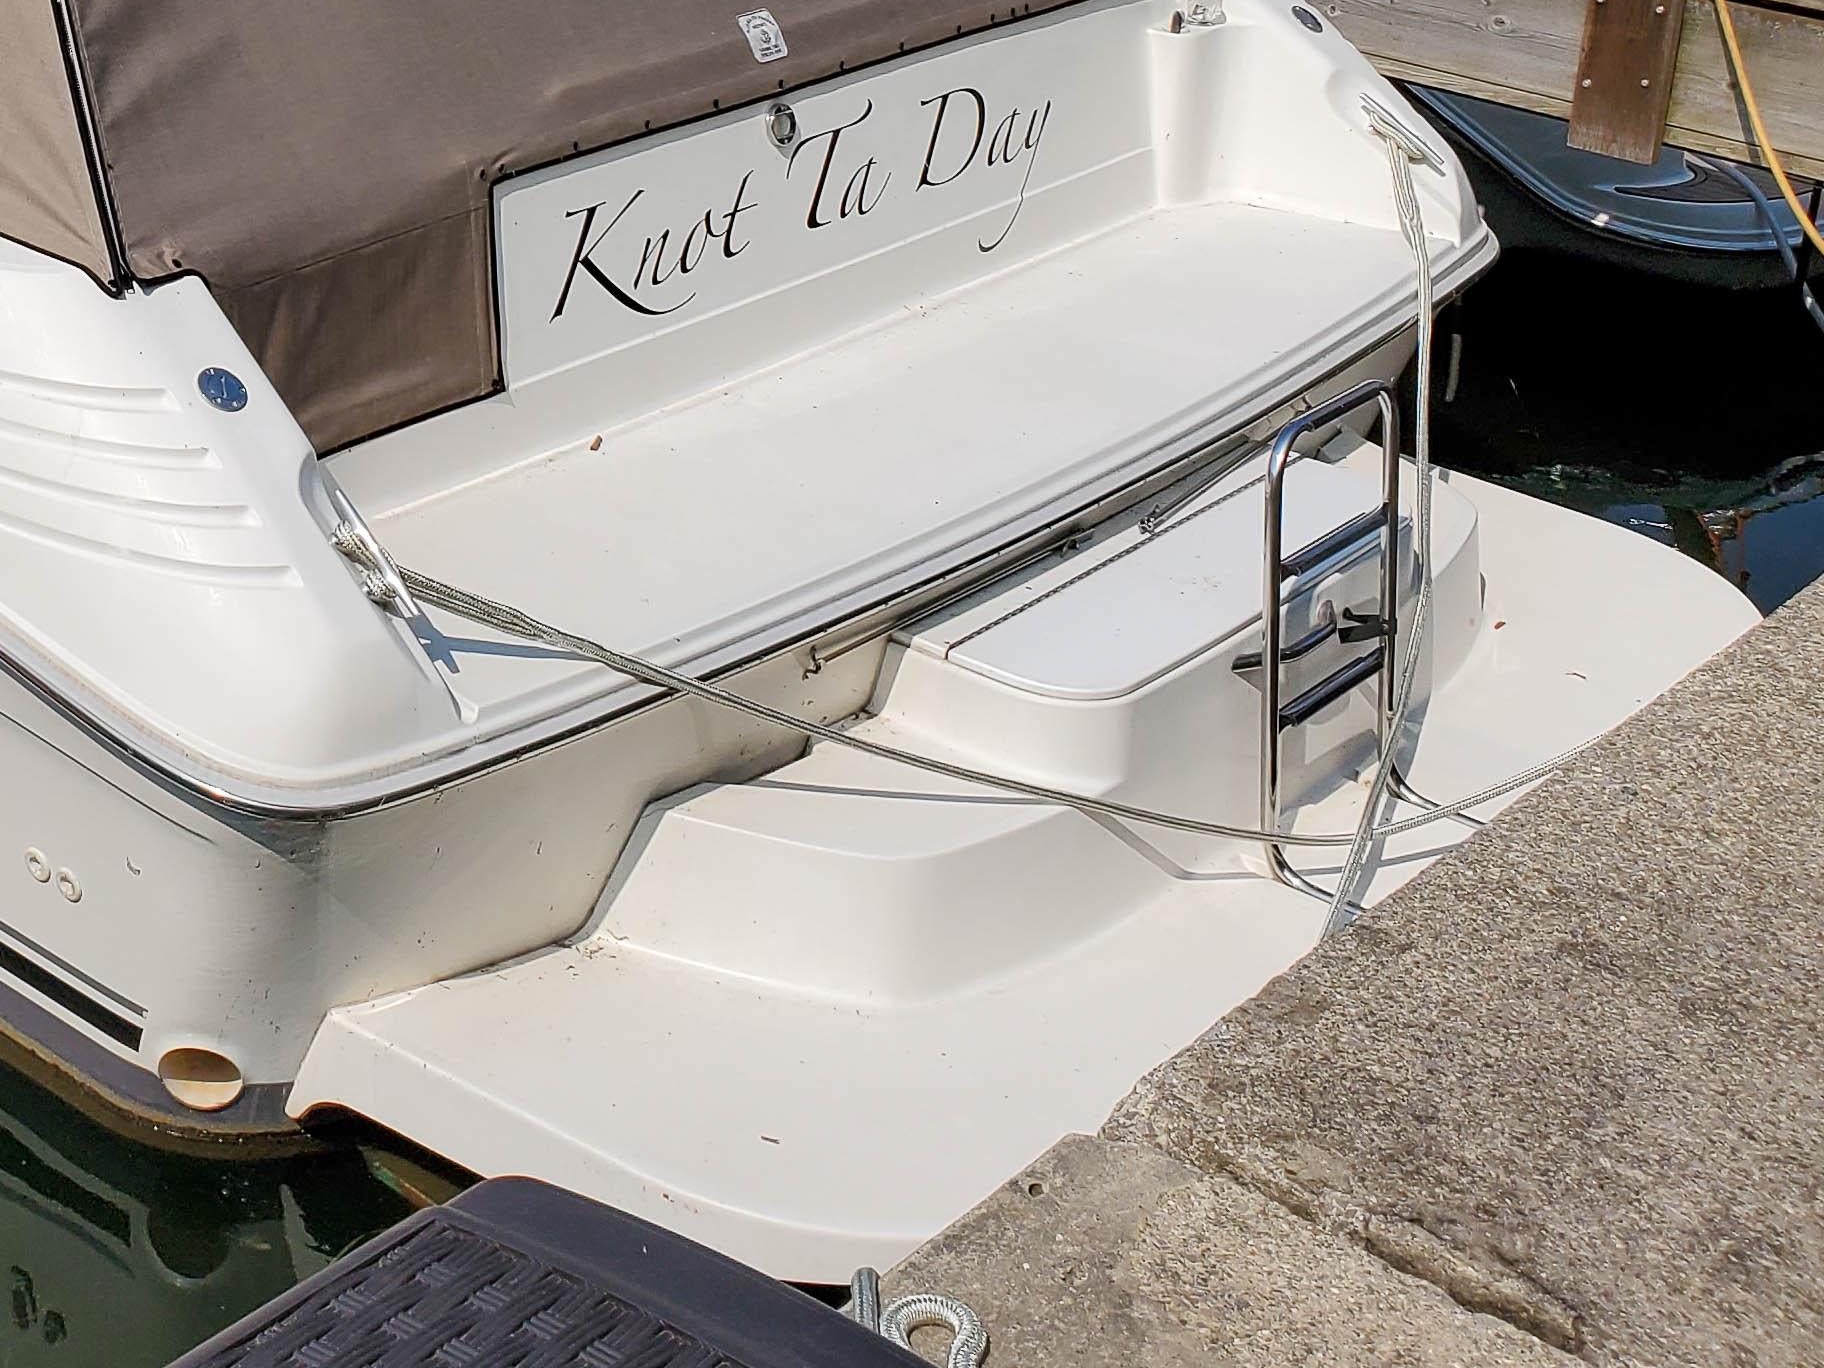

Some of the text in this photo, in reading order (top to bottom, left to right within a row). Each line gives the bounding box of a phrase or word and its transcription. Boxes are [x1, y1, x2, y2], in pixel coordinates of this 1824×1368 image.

[549, 88, 1052, 323] Knot Ta Day
